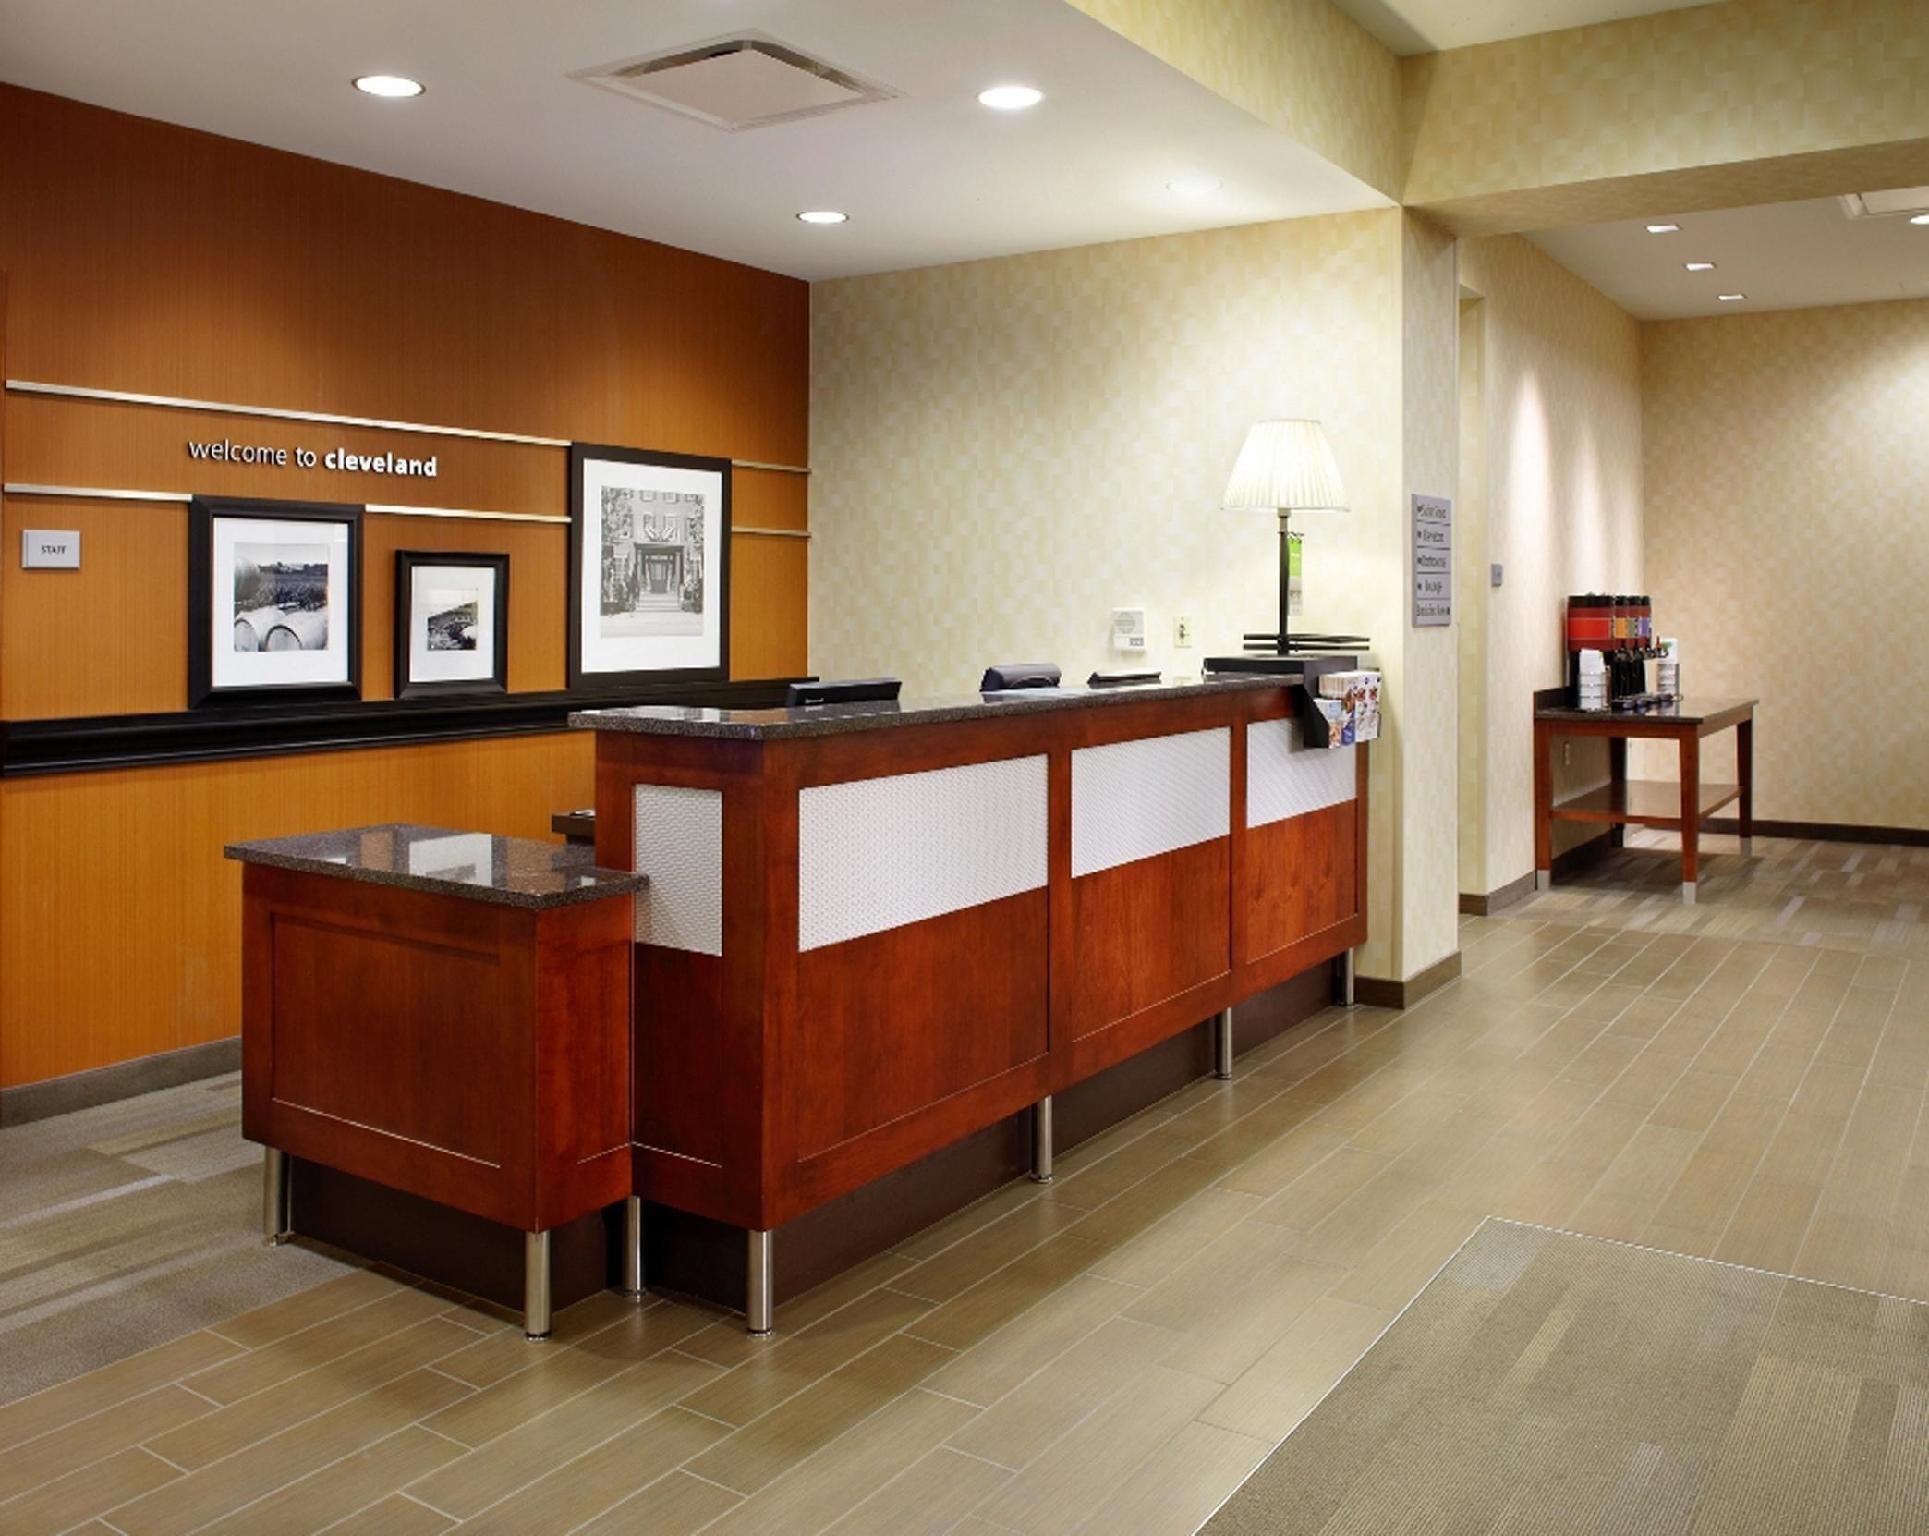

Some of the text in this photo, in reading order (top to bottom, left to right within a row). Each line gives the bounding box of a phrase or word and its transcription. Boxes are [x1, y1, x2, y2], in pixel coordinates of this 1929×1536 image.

[187, 438, 438, 478] welcome to cleveland
